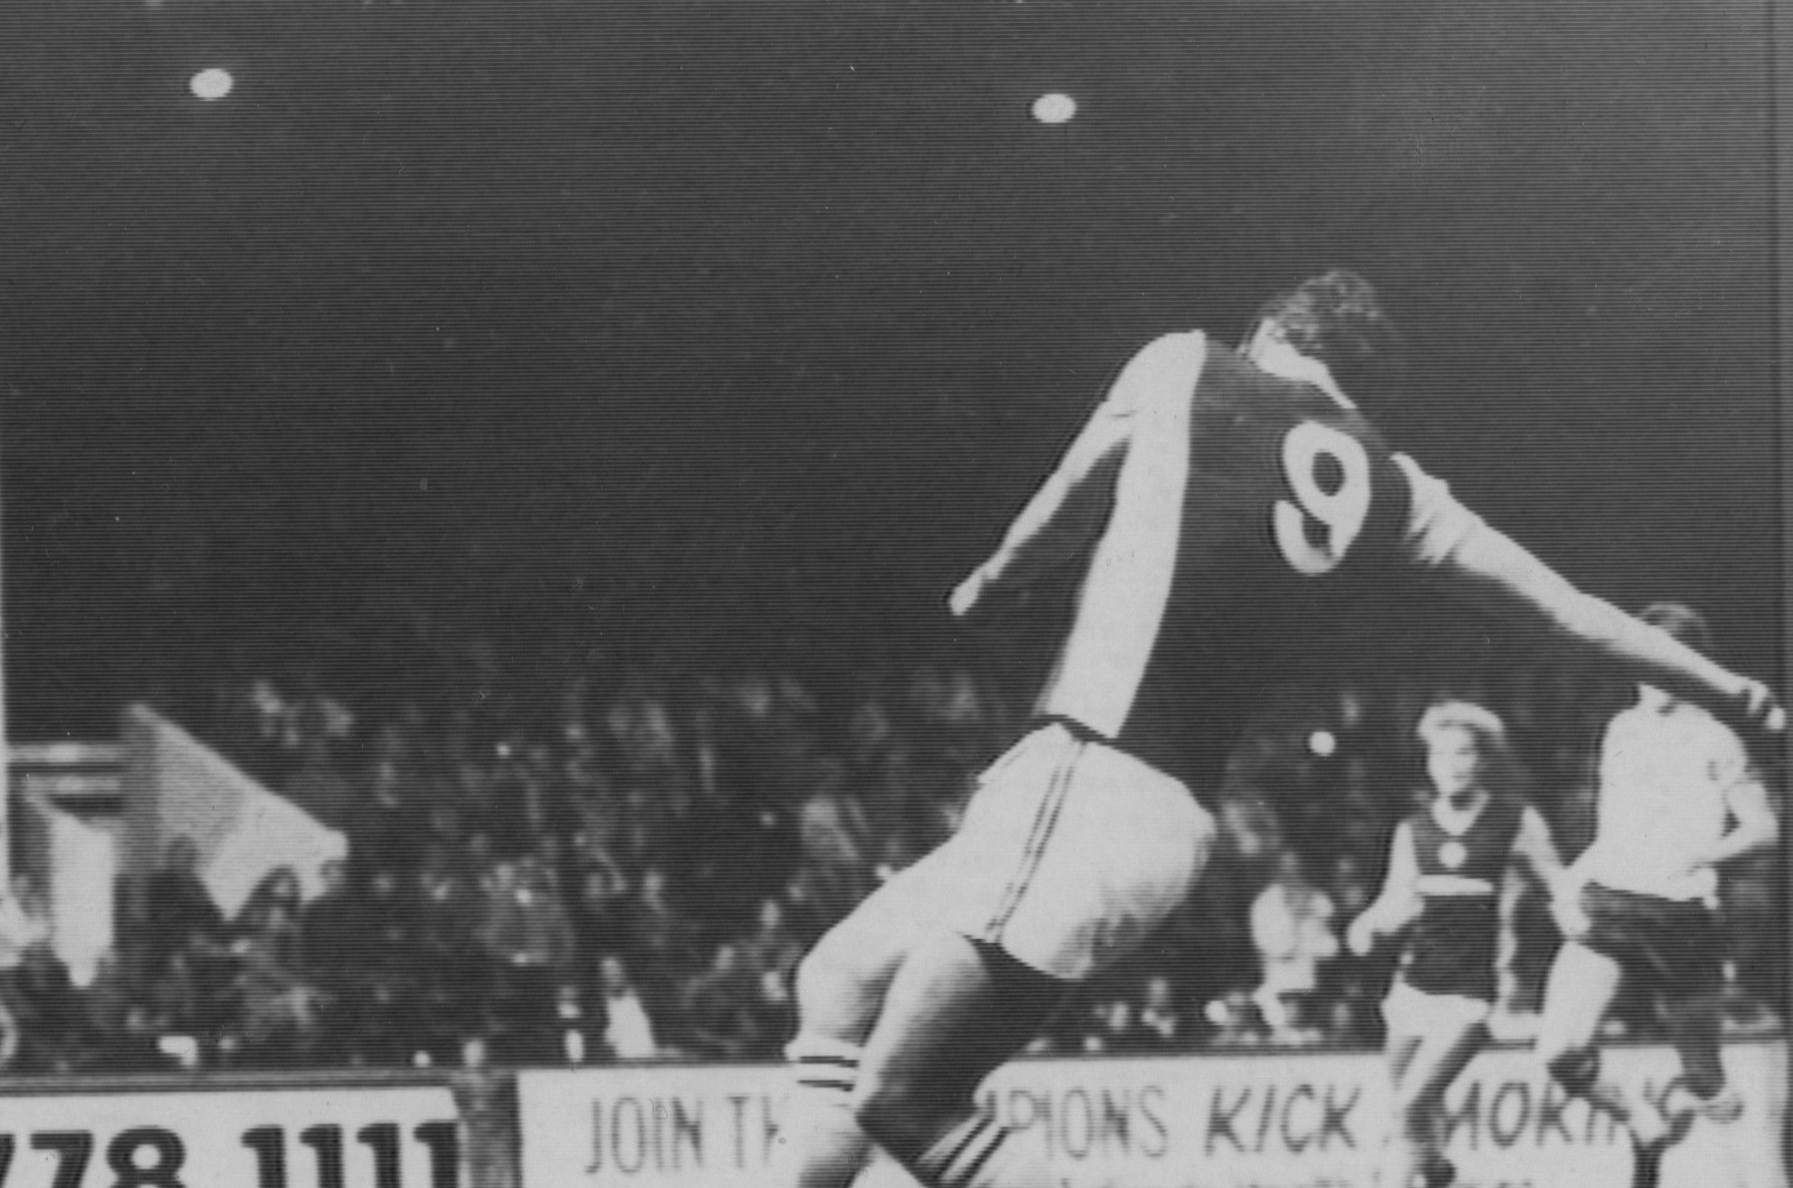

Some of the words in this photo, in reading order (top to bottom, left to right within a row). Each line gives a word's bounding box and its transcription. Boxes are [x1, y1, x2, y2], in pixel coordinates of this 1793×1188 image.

[1273, 420, 1371, 575] 9
[583, 1096, 706, 1174] JOIN
[1206, 1083, 1360, 1155] KICK
